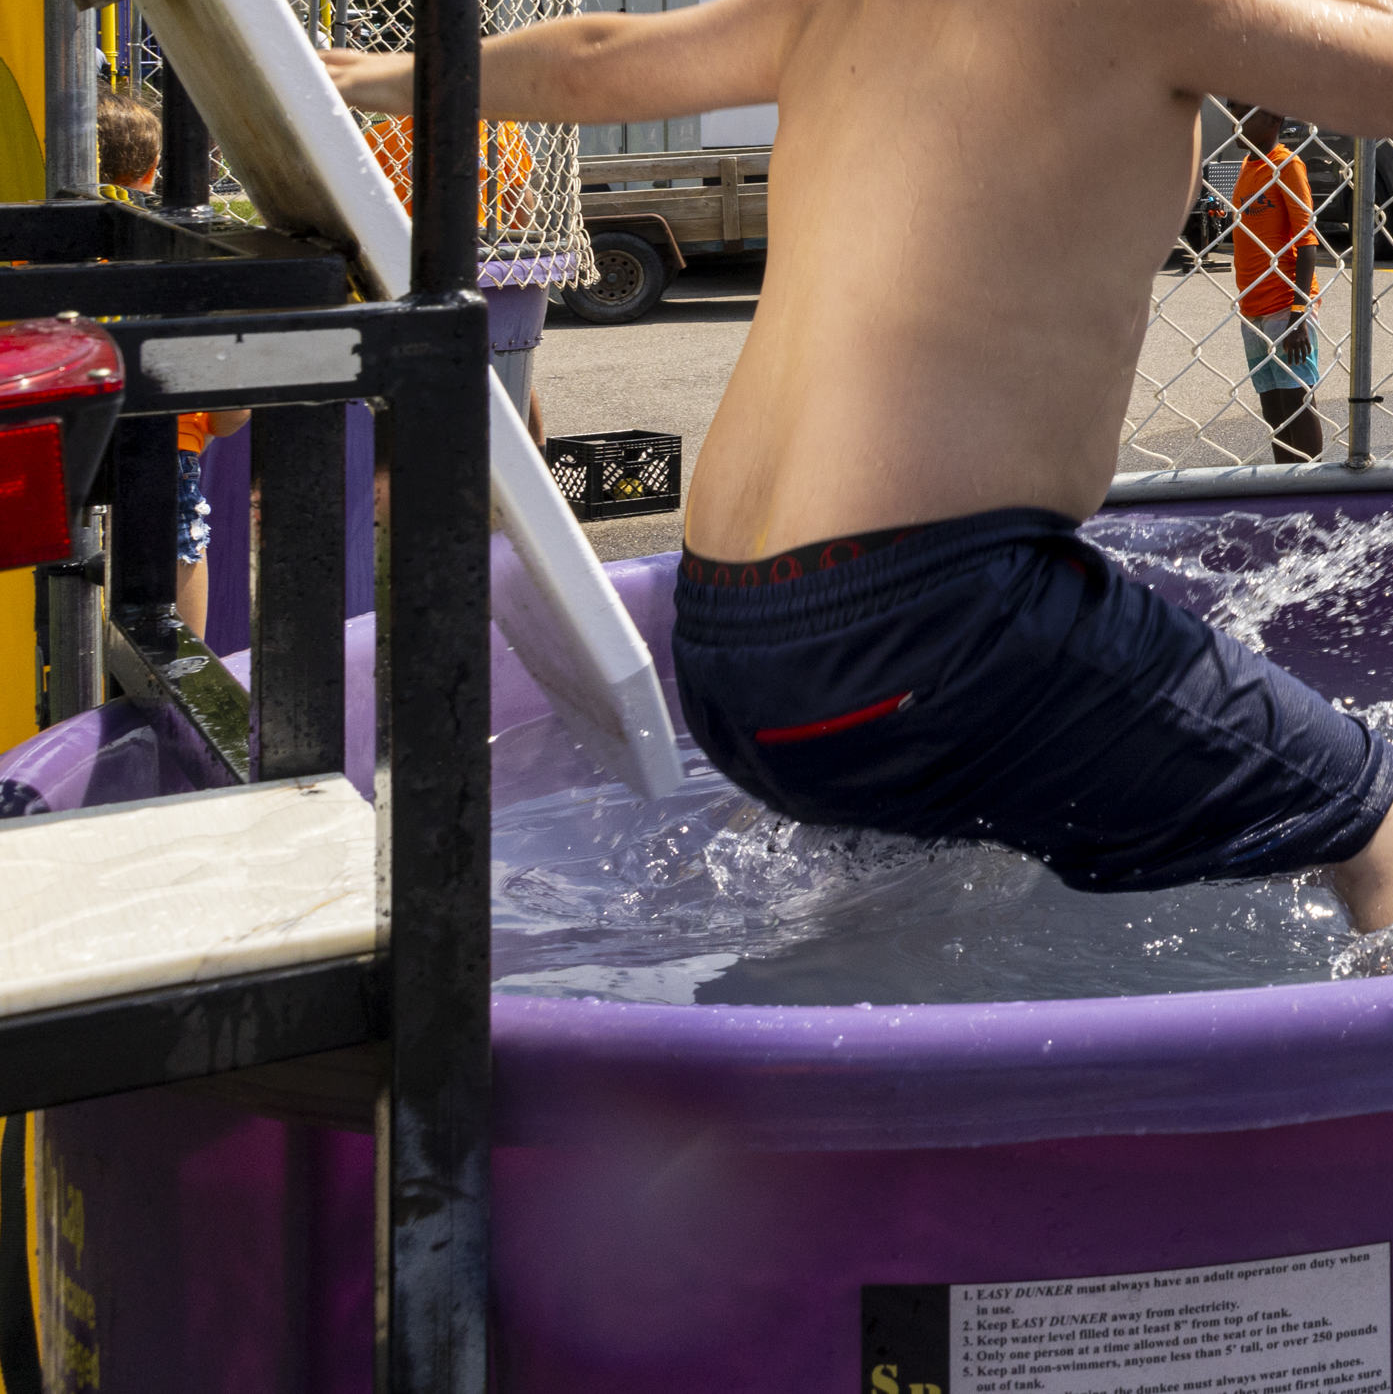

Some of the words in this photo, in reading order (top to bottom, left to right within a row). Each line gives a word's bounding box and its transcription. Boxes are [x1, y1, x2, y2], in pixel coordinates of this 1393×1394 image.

[963, 1290, 973, 1301] 1.
[976, 1288, 1013, 1301] EASY
[1015, 1285, 1073, 1299] DUNKER
[1077, 1283, 1106, 1294] must
[1110, 1281, 1150, 1292] always
[1153, 1277, 1182, 1288] have
[1185, 1275, 1200, 1285] an
[1203, 1270, 1234, 1283] adult
[1237, 1265, 1289, 1280] operator
[1291, 1262, 1306, 1272] on
[1310, 1258, 1336, 1269] duty
[1340, 1253, 1370, 1264] when
[963, 1321, 973, 1331] 2.
[976, 1320, 1008, 1332] Keep
[1011, 1316, 1047, 1329] EASY
[1049, 1312, 1108, 1327] DUNKER
[1111, 1311, 1142, 1322] away
[1146, 1308, 1175, 1319] from
[1178, 1300, 1240, 1313] electricity.
[963, 1335, 973, 1346] 3.
[976, 1334, 1008, 1347] Keep
[1011, 1334, 1045, 1344] water
[1048, 1331, 1076, 1342] level
[1079, 1328, 1110, 1340] filled
[1113, 1327, 1125, 1337] to
[1128, 1326, 1139, 1336] at
[1143, 1323, 1171, 1334] least
[1191, 1317, 1221, 1329] from
[1224, 1315, 1244, 1326] top
[1246, 1311, 1260, 1322] of
[1262, 1308, 1292, 1320] tank.
[976, 1305, 988, 1315] in
[992, 1306, 1015, 1315] use.
[963, 1352, 973, 1362] 4.
[976, 1350, 1006, 1363] Only
[1009, 1351, 1031, 1360] one
[1034, 1347, 1074, 1361] person
[1078, 1345, 1089, 1355] at
[1093, 1346, 1100, 1354] a
[1103, 1342, 1131, 1353] time
[1133, 1337, 1180, 1350] allowed
[1183, 1336, 1198, 1345] on
[1201, 1332, 1220, 1343] the
[1223, 1330, 1247, 1340] seat
[1249, 1327, 1263, 1337] or
[1266, 1325, 1278, 1335] in
[1281, 1322, 1300, 1333] the
[1303, 1317, 1333, 1329] tank.
[963, 1366, 973, 1377] 5.
[976, 1365, 1008, 1377] Keep
[1011, 1364, 1026, 1375] all
[1030, 1359, 1121, 1374] non-swimmers,
[1124, 1355, 1167, 1367] anyone
[1170, 1351, 1191, 1362] less
[1195, 1347, 1222, 1359] than
[1240, 1341, 1264, 1353] tall,
[1266, 1341, 1280, 1350] or
[1283, 1337, 1309, 1347] over
[1312, 1330, 1333, 1343] 250
[1336, 1324, 1378, 1342] pounds
[976, 1382, 996, 1392] out
[999, 1380, 1012, 1390] of
[1014, 1378, 1045, 1390] tank.
[1136, 1383, 1180, 1394] dunkee
[1183, 1378, 1212, 1391] must
[1216, 1373, 1256, 1387] always
[1260, 1369, 1289, 1380] wear
[1292, 1362, 1327, 1376] tennis
[1330, 1358, 1365, 1370] shoes.
[1263, 1382, 1292, 1394] must
[1295, 1378, 1320, 1391] first
[1323, 1373, 1355, 1386] make
[1357, 1368, 1382, 1380] sure
